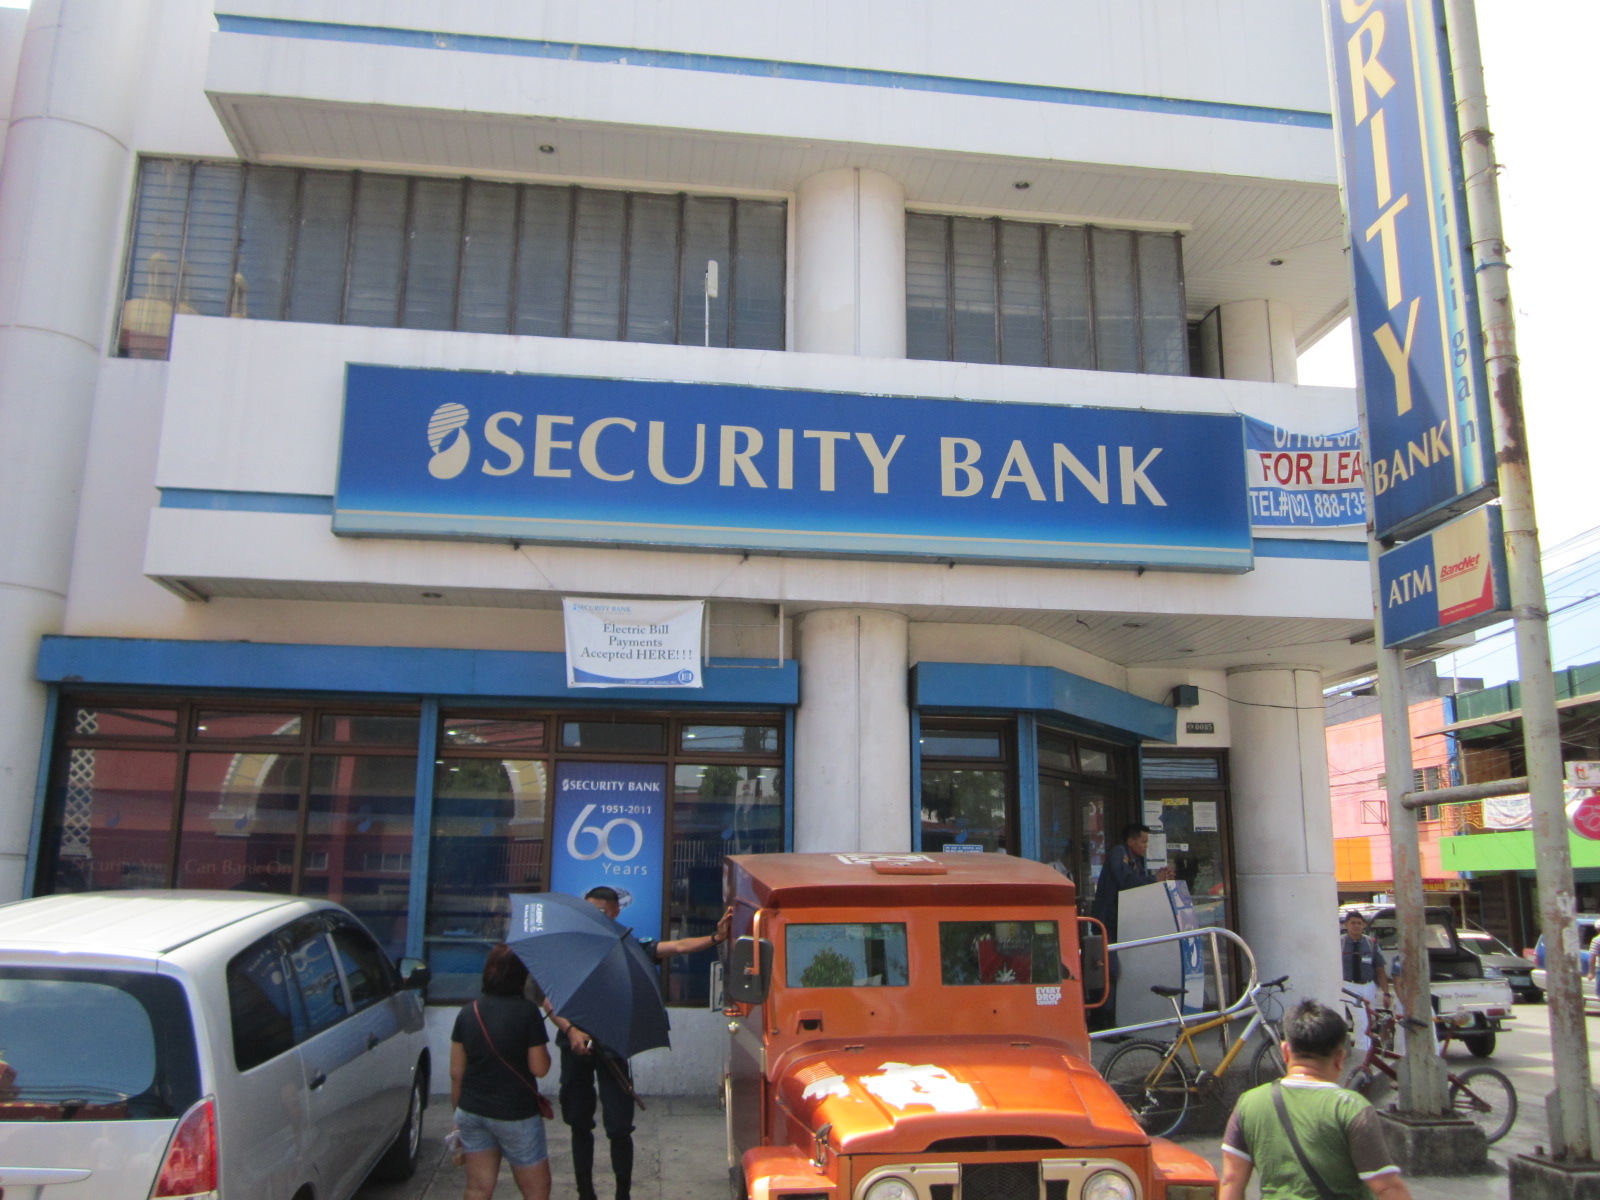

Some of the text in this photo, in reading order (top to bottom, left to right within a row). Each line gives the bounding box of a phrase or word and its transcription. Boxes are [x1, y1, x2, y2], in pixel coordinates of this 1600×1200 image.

[481, 411, 1168, 507] SECURITY BANK
[1373, 419, 1451, 497] BANK
[1259, 452, 1313, 485] FOR
[1440, 553, 1481, 579] BancNet
[1388, 564, 1434, 609] ATM
[577, 603, 609, 612] SECURITY
[612, 605, 632, 613] BANK
[603, 623, 669, 635] Electric Bill
[608, 635, 663, 649] Payments
[580, 647, 633, 661] Accepted
[570, 780, 660, 792] SECURITY BANK
[601, 805, 652, 815] 1951-2011
[566, 804, 643, 862] 60
[602, 863, 648, 876] Years
[1035, 986, 1062, 994] EVERY
[1036, 993, 1062, 1001] DROP
